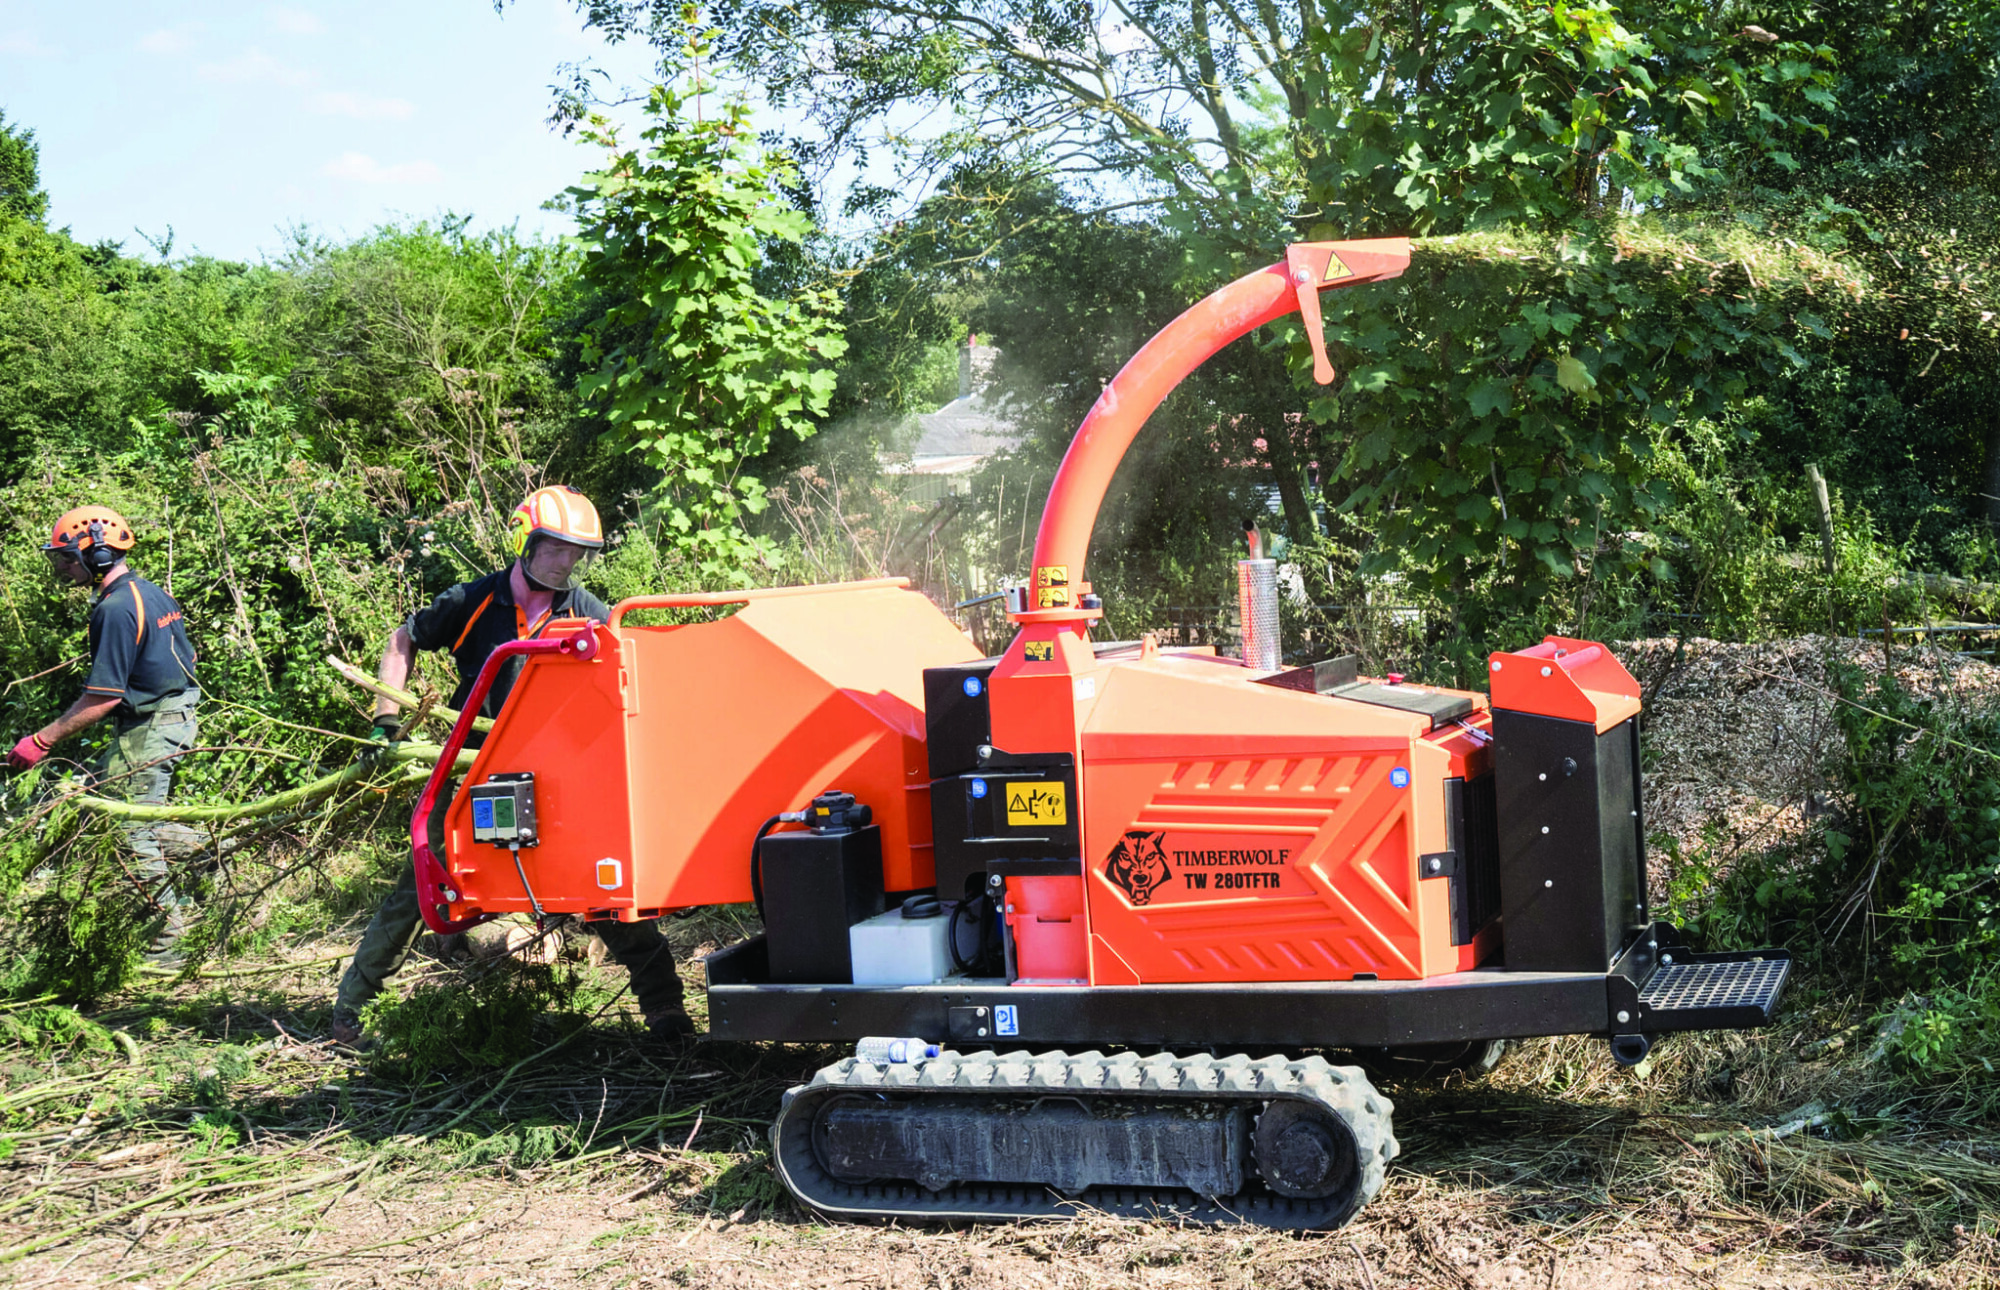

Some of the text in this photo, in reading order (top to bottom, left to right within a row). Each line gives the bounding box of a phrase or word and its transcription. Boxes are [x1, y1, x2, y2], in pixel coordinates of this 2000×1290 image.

[1173, 849, 1289, 866] TIMBERWOLF
[1184, 872, 1280, 889] TW 280TFTR
